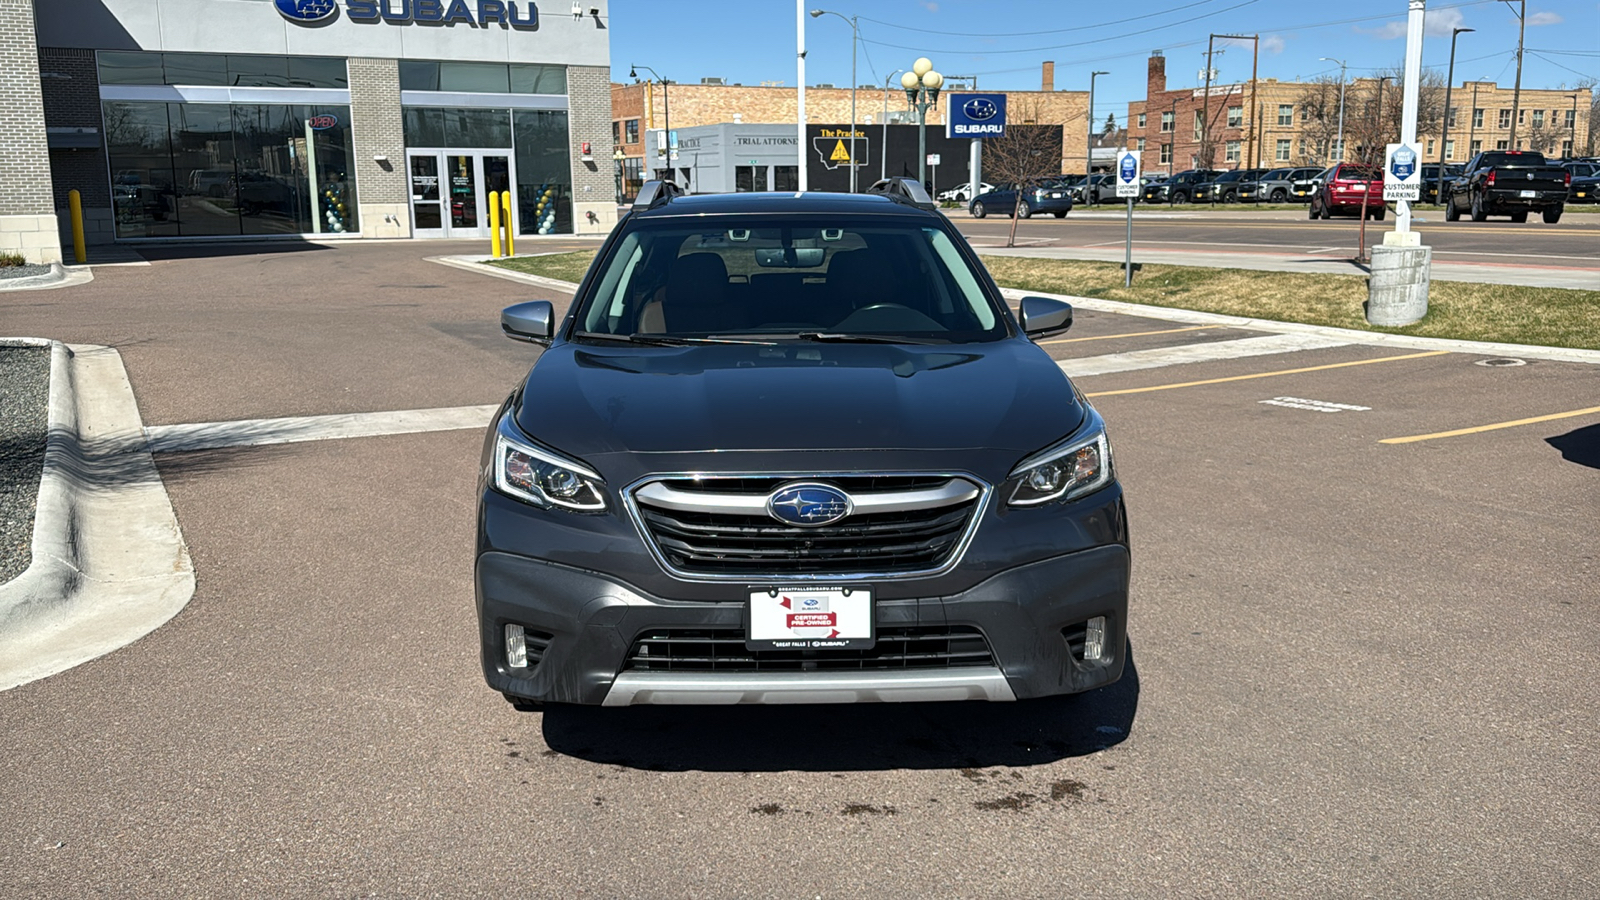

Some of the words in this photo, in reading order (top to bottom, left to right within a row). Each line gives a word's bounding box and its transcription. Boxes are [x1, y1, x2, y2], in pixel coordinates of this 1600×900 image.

[346, 0, 537, 27] SUBARU
[309, 116, 335, 127] OPEN
[820, 128, 835, 137] The
[836, 128, 865, 137] Pracice
[954, 124, 1003, 133] SUBARU
[1384, 183, 1420, 191] CUSTOMER
